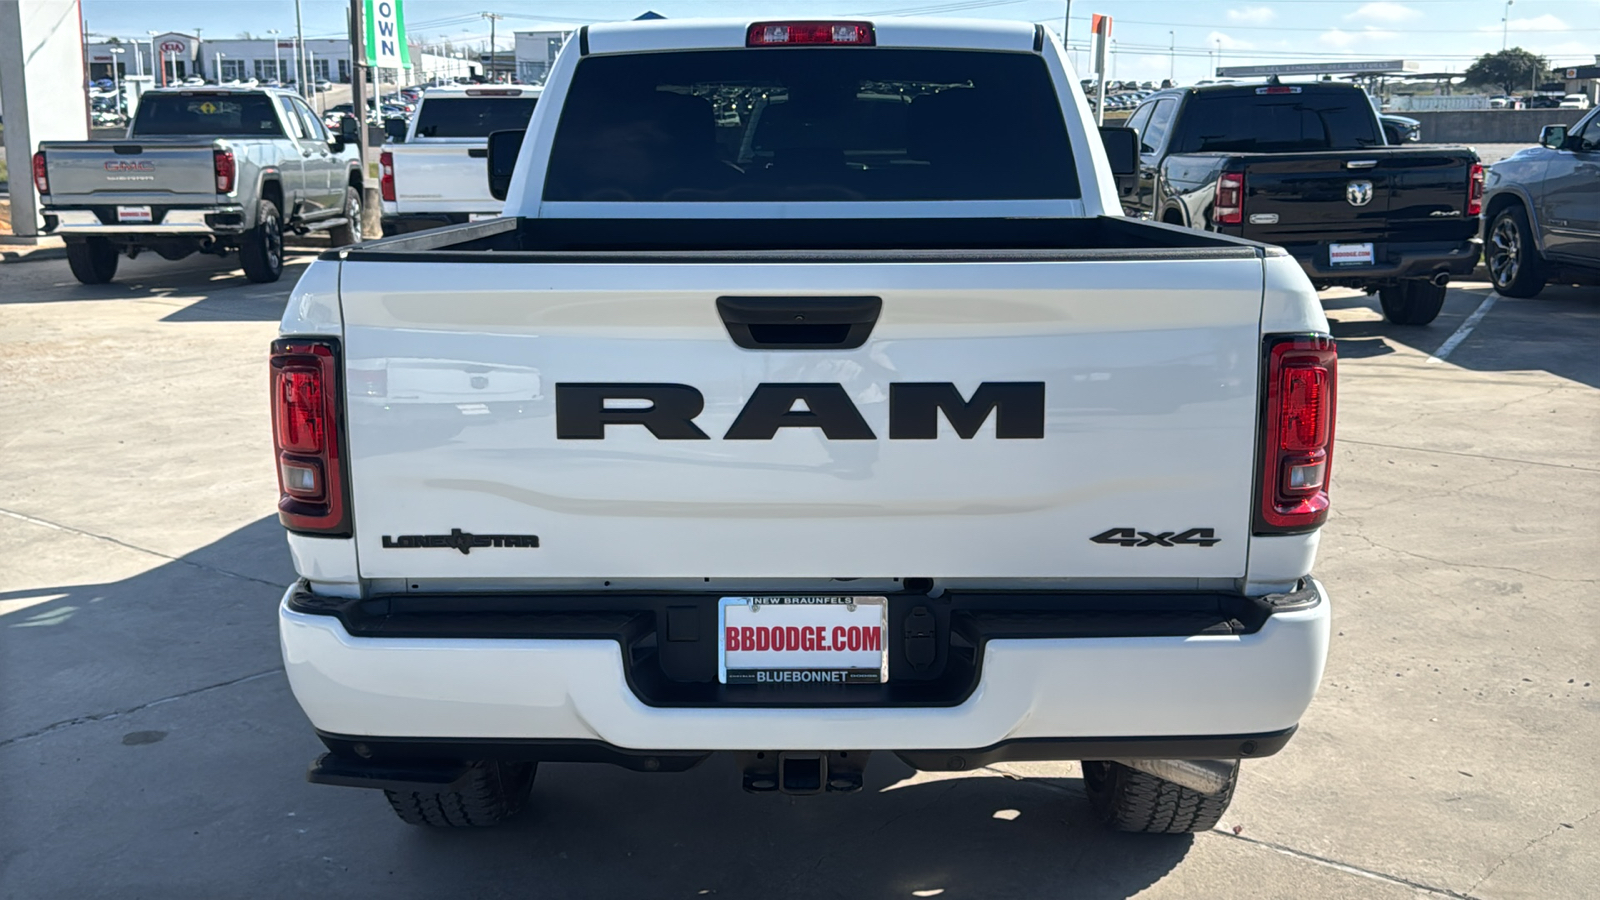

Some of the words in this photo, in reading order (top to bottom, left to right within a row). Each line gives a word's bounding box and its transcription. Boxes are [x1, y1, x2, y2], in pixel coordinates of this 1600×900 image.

[164, 42, 181, 51] KIA
[104, 161, 155, 172] GMC
[555, 382, 1045, 440] RAM
[382, 534, 444, 548] LONE
[472, 534, 540, 548] STAR
[1089, 527, 1222, 547] 4x4
[726, 626, 881, 652] BBDODGE.COM
[756, 671, 848, 683] BLUEBONNET
